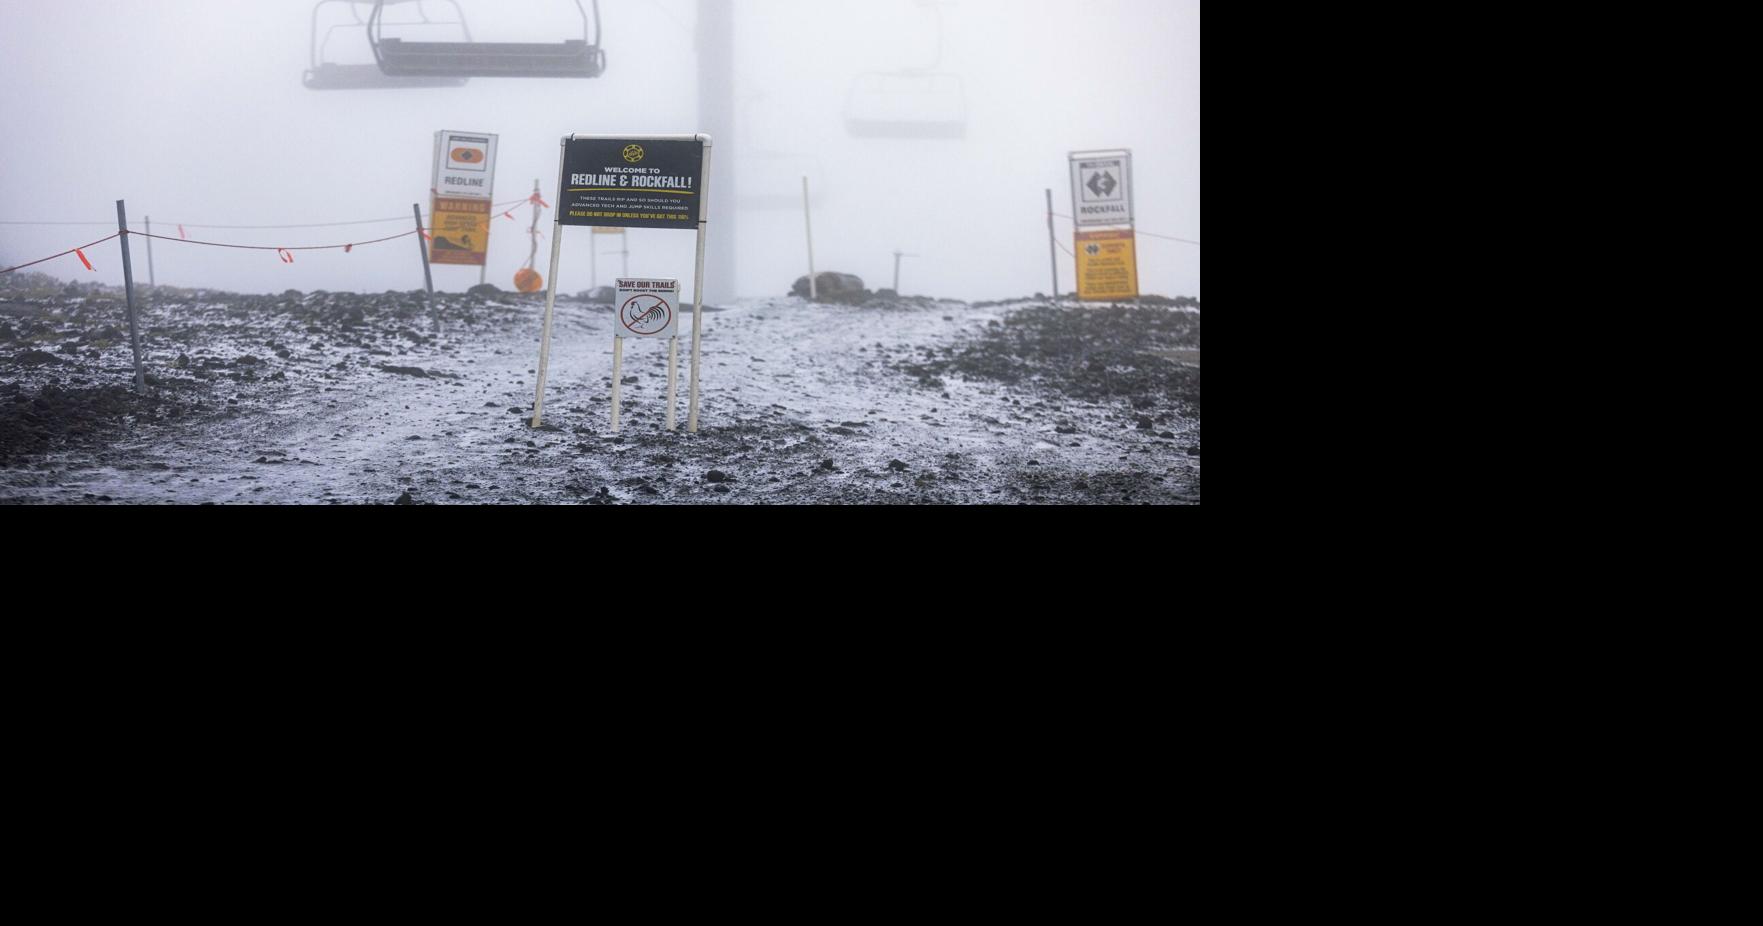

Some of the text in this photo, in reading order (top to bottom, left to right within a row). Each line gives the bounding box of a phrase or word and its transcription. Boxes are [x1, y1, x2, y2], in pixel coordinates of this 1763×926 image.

[444, 176, 484, 187] REDLINE
[570, 173, 692, 189] REDLINE & ROCKFALL!
[1080, 205, 1125, 214] ROCKFALL
[652, 281, 675, 289] TRAILS
